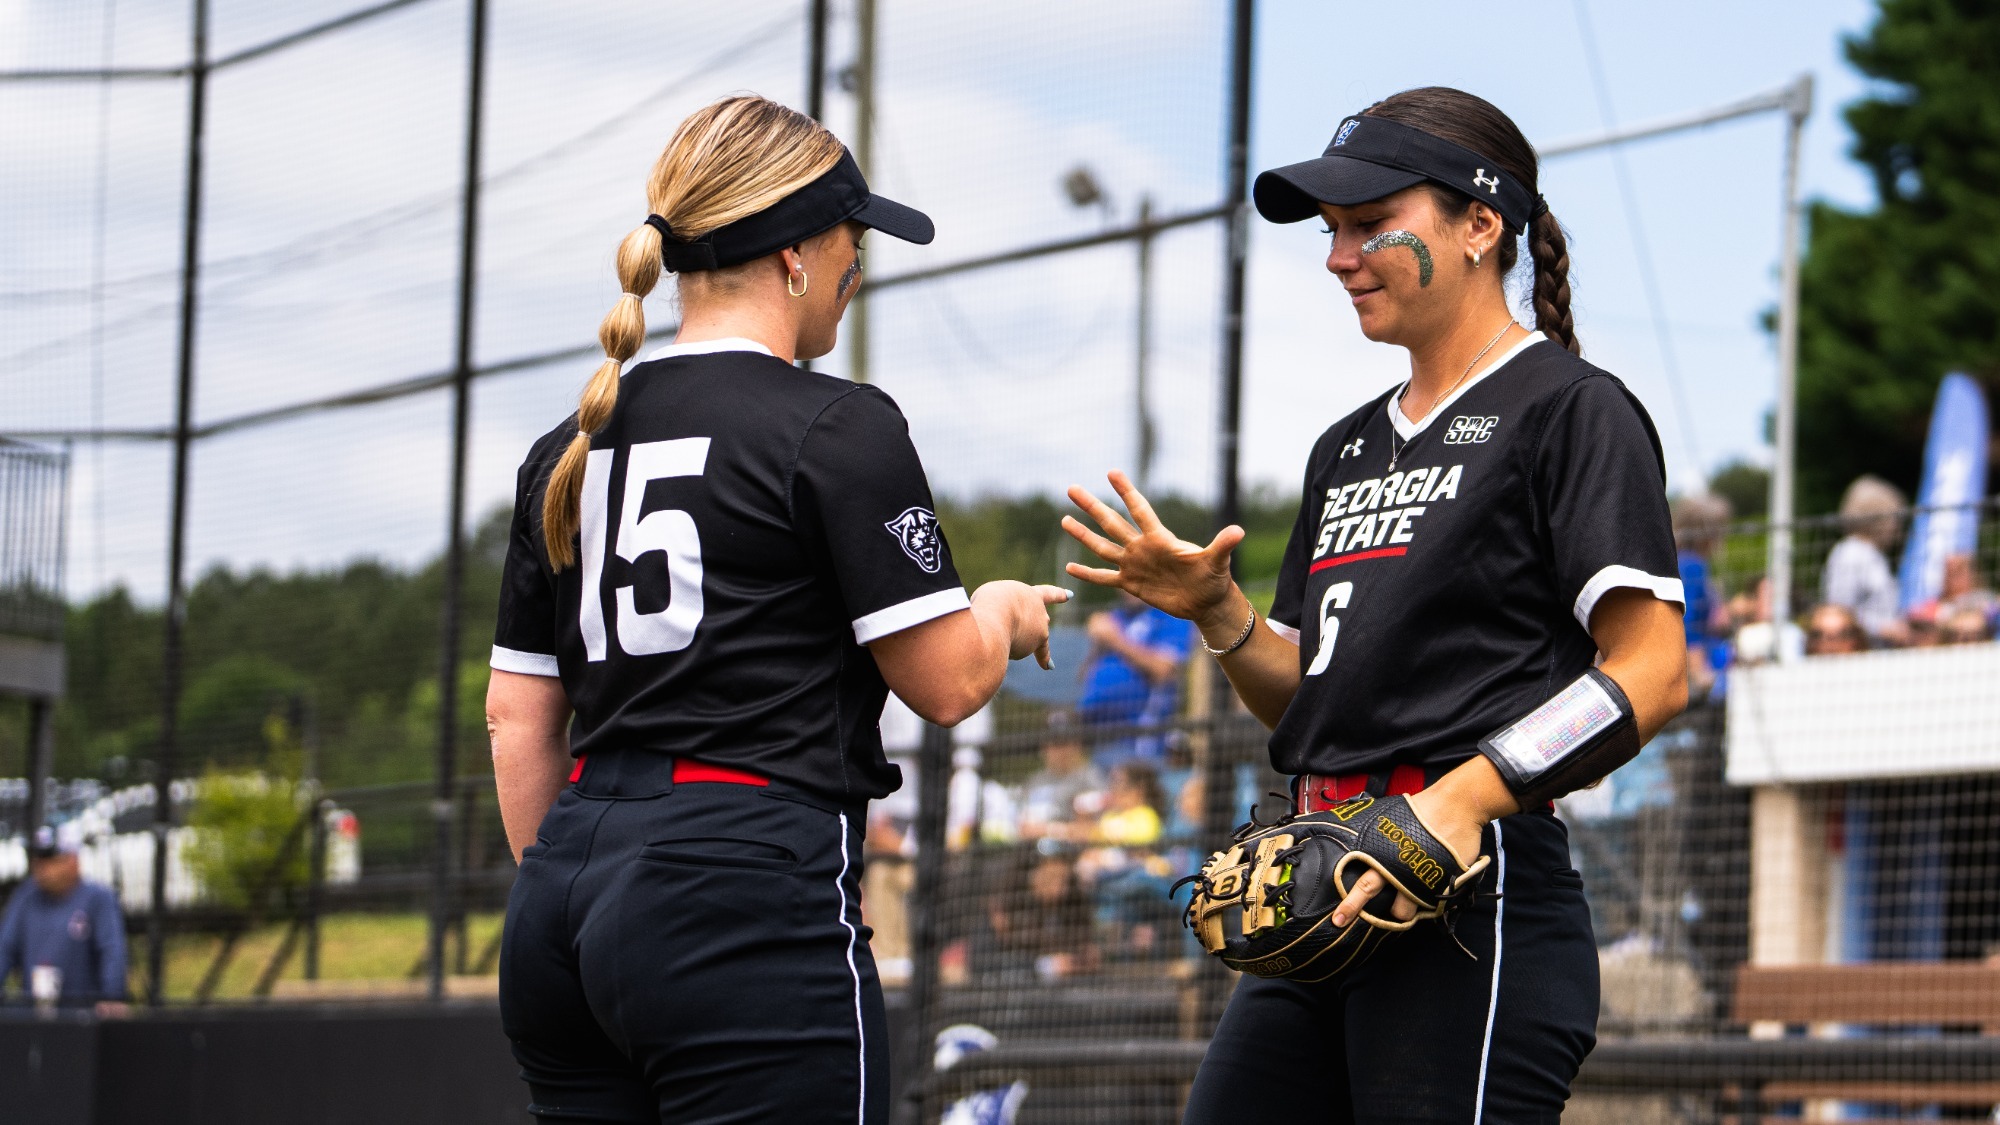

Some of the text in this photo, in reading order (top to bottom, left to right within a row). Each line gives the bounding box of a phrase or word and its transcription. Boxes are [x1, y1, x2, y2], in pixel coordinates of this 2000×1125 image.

[1444, 416, 1499, 444] SBC
[1320, 465, 1463, 526] GEORGIA
[579, 437, 711, 662] 15
[1313, 507, 1426, 560] STATE
[1306, 582, 1354, 676] 6
[1378, 816, 1444, 890] Wilson
